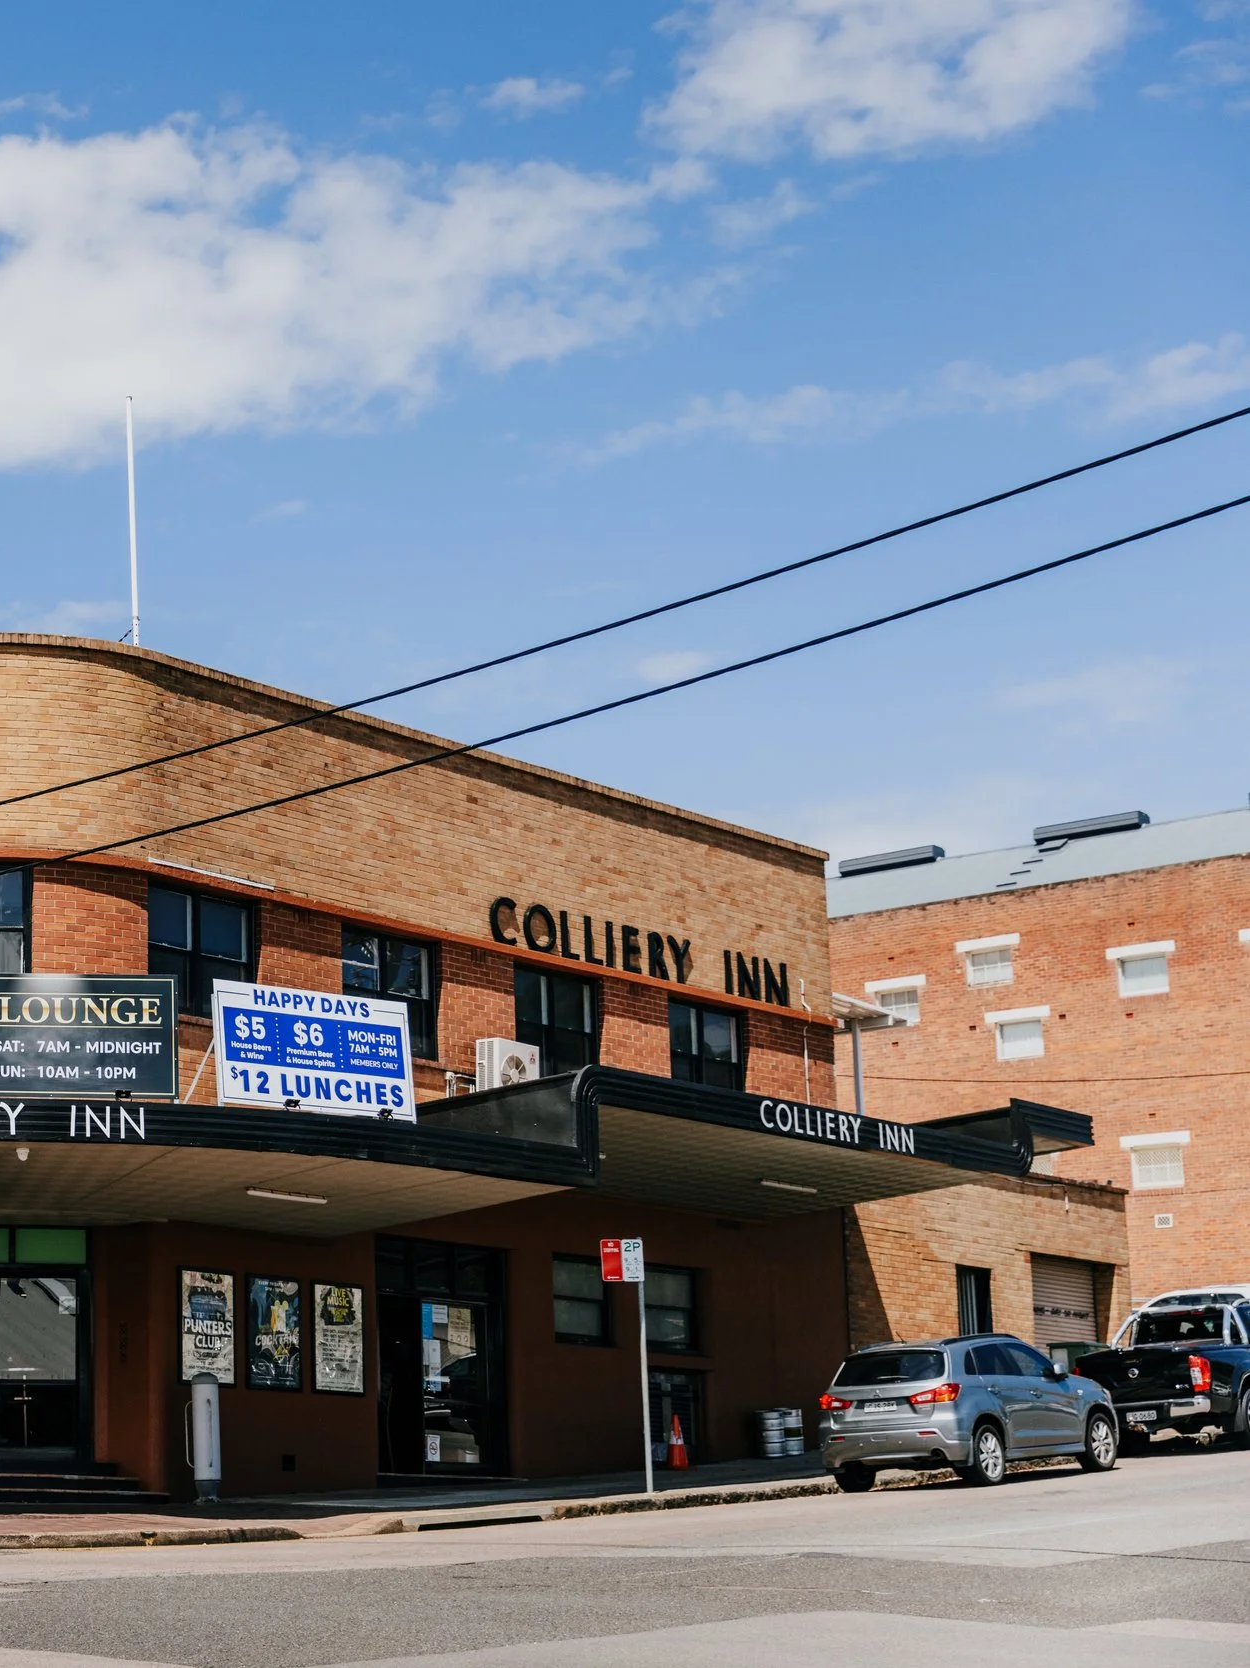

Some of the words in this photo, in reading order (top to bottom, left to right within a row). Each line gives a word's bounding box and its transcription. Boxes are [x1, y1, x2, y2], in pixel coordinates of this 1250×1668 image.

[489, 896, 692, 984] COLLIERY
[723, 950, 791, 1008] INN
[253, 988, 316, 1012] HAPPY
[320, 998, 370, 1018] DAYS
[234, 1013, 267, 1040] $5
[292, 1020, 325, 1047] $6
[347, 1029, 397, 1047] MON-FRI
[37, 1040, 70, 1053] 7AM
[86, 1041, 162, 1055] MIDNIGHT
[231, 1040, 253, 1050] House
[252, 1043, 272, 1052] Beers
[286, 1047, 318, 1057] Premium
[317, 1049, 334, 1059] Beer
[349, 1043, 370, 1055] 7AM
[378, 1046, 398, 1058] 5PM
[240, 1051, 246, 1059] &
[246, 1051, 265, 1061] Wine
[285, 1055, 292, 1064] &
[292, 1056, 314, 1066] House
[313, 1058, 336, 1068] Spirits
[350, 1057, 381, 1069] MEMBERS
[381, 1061, 399, 1070] ONLY
[37, 1066, 80, 1079] 10AM
[95, 1066, 136, 1080] 10PM
[230, 1066, 270, 1095] $12
[280, 1073, 405, 1108] LUNCHES
[69, 1104, 146, 1140] INN
[759, 1099, 862, 1144] COLLIERY
[878, 1122, 915, 1155] INN
[623, 1241, 641, 1252] 2P
[330, 1287, 347, 1298] LIVE
[326, 1296, 350, 1307] MUSIC
[183, 1316, 232, 1336] PUNTERS
